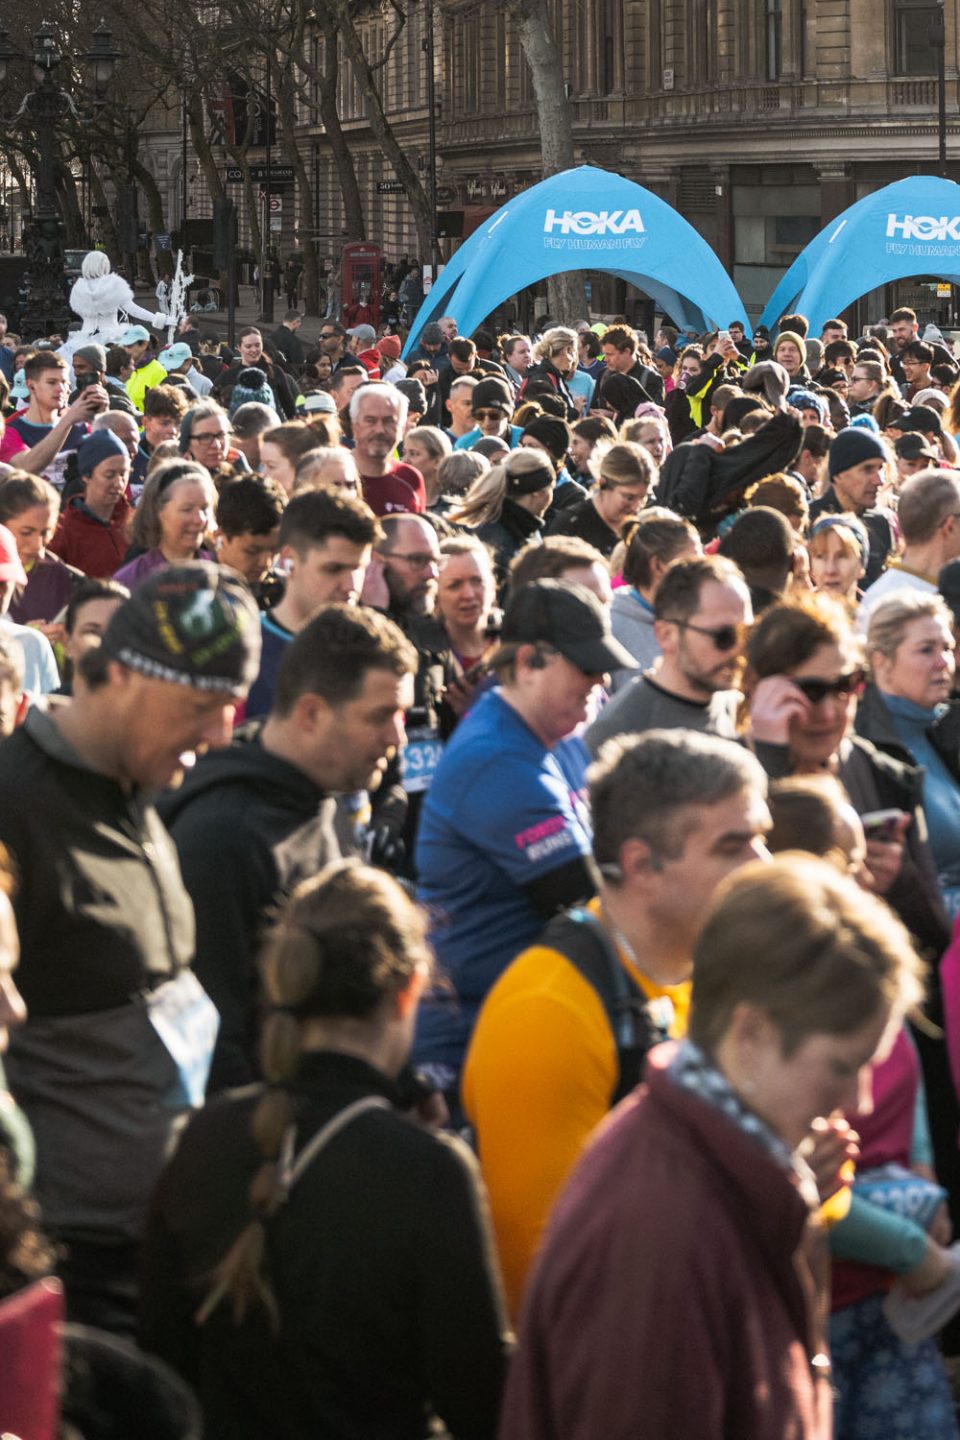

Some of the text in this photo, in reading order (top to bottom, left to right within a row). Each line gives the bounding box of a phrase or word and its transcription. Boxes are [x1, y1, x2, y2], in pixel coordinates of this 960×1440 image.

[543, 208, 645, 235] HOKA
[543, 237, 646, 250] FLY HUMAN FLY
[885, 243, 908, 255] FLY
